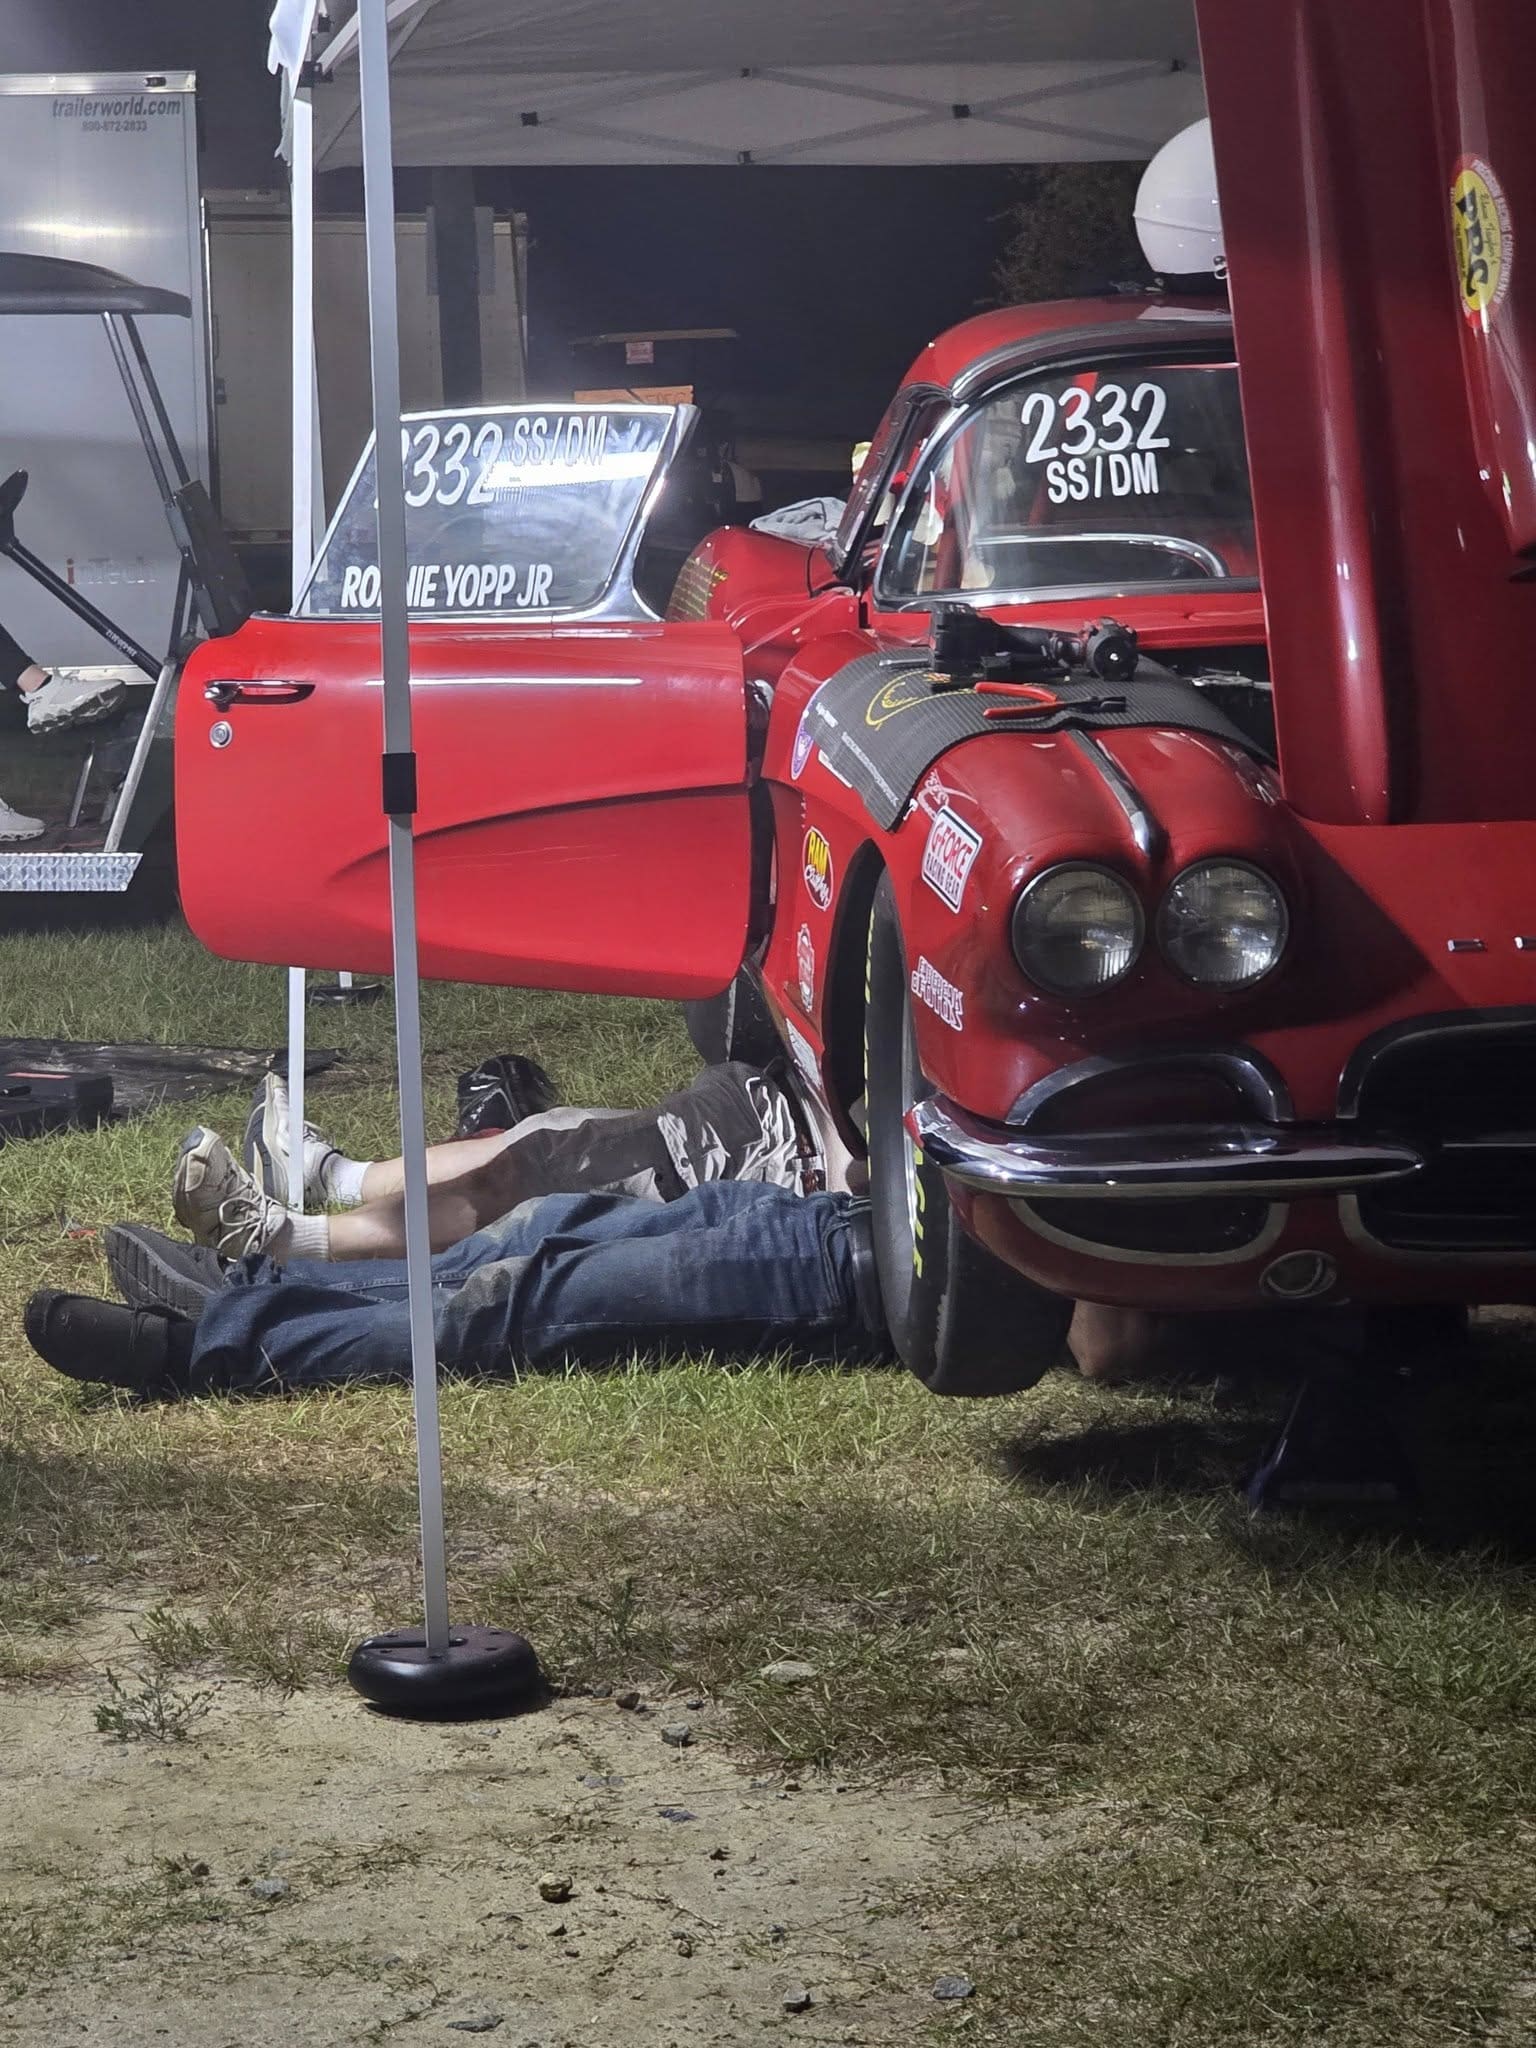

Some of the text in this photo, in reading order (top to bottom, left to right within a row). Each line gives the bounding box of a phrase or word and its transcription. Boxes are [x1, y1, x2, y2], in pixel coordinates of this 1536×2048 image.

[52, 96, 181, 117] trailerworld.com
[511, 416, 608, 466] SS/DM
[1021, 383, 1170, 463] 2332
[1046, 452, 1159, 504] SS/DM
[341, 564, 553, 608] ROIE YOPP JR
[808, 831, 829, 877] RAM
[945, 871, 960, 897] GEAR
